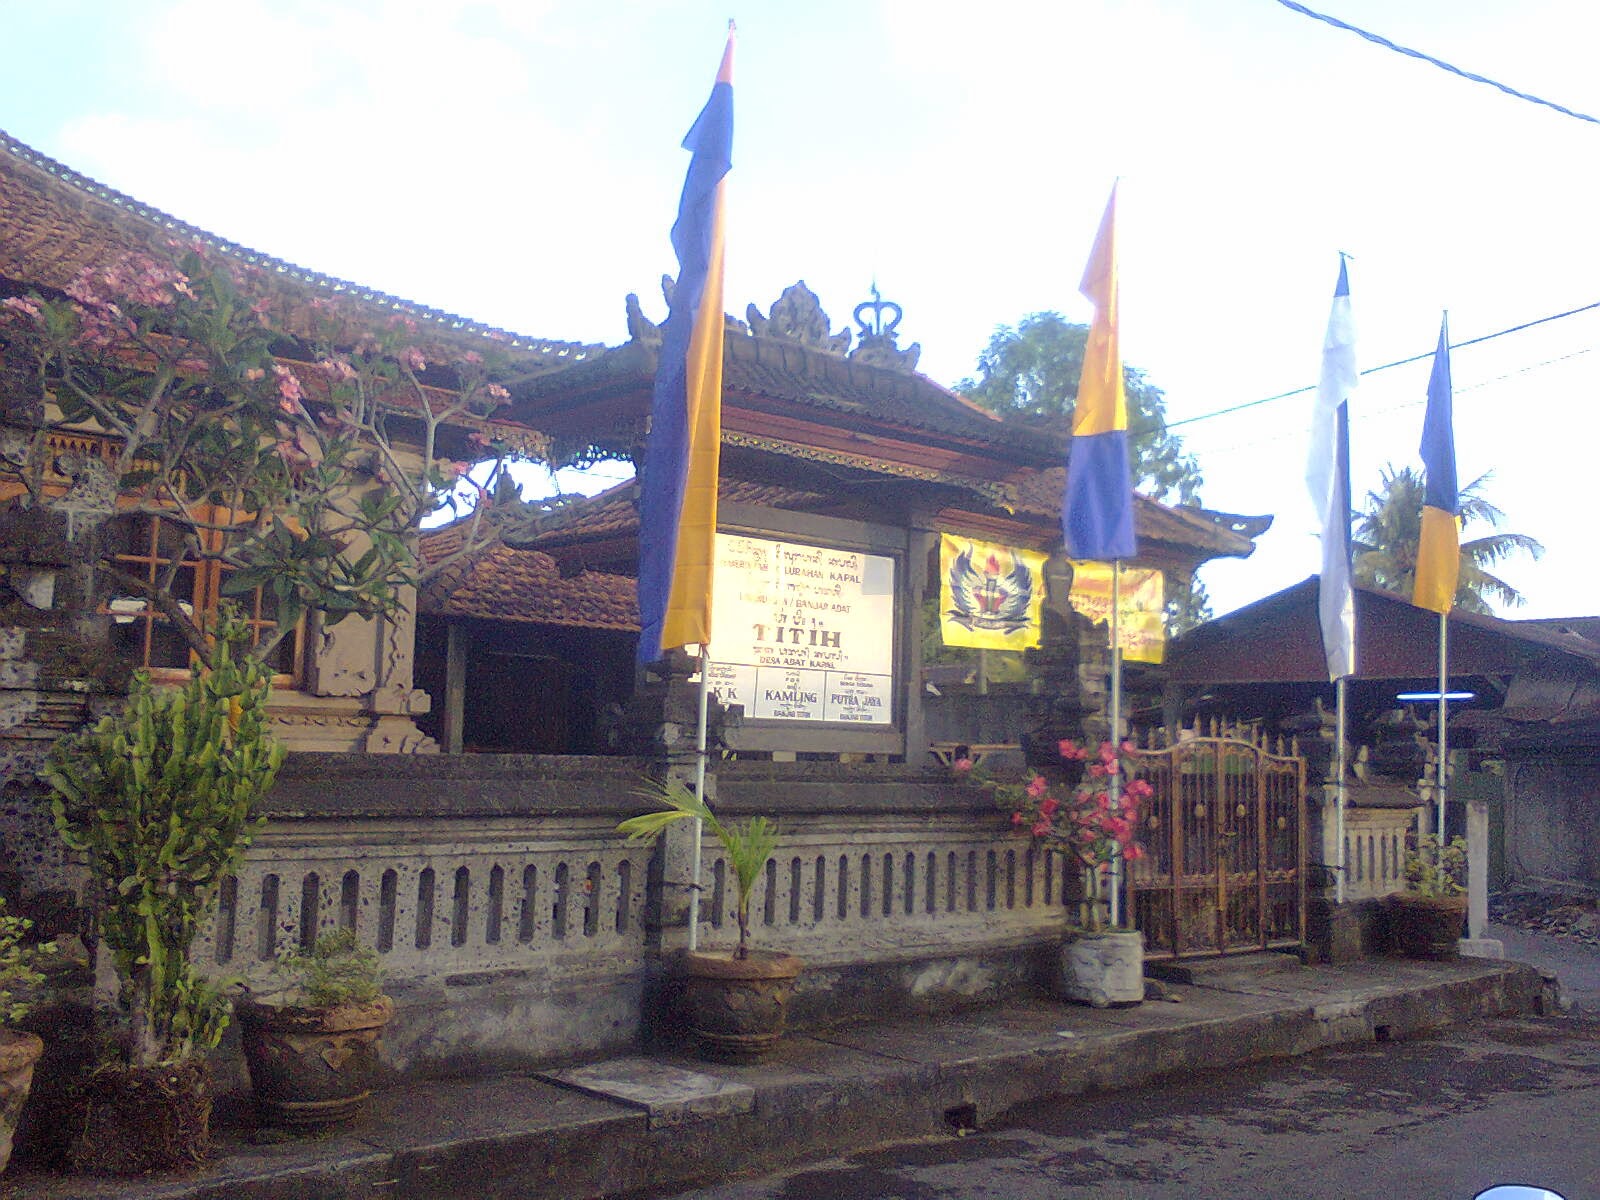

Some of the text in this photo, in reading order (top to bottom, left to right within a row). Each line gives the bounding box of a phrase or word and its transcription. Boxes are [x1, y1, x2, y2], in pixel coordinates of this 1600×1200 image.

[830, 571, 862, 584] KAPAL
[752, 623, 841, 648] TITIH
[760, 656, 781, 665] DESA
[765, 689, 817, 703] KAMLING
